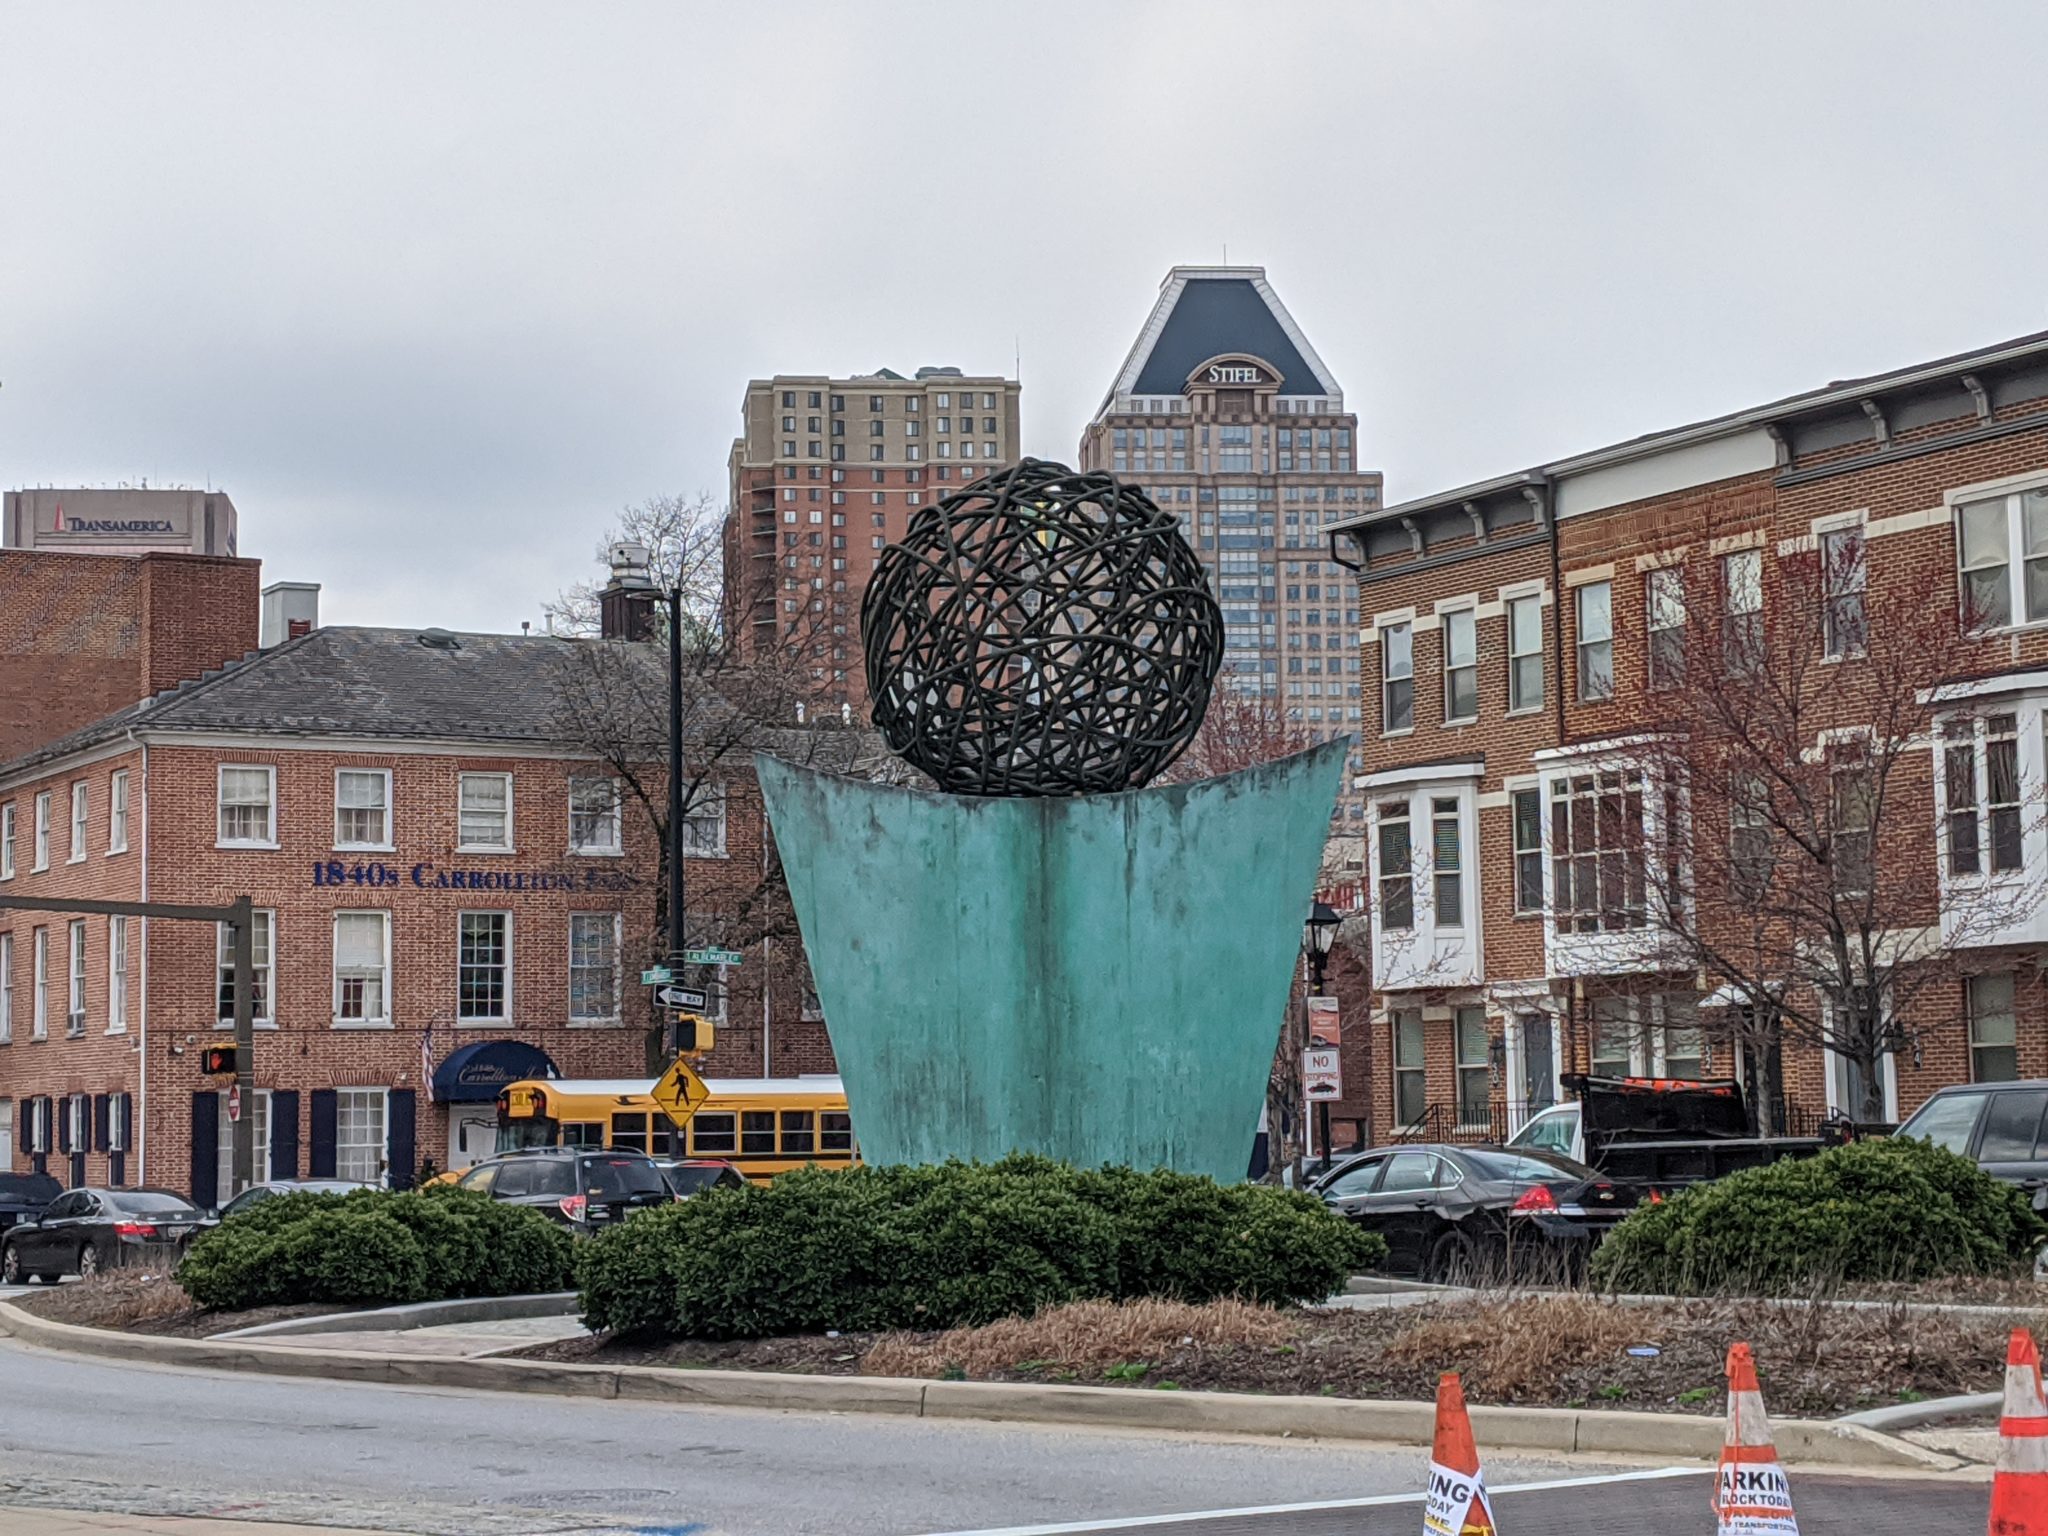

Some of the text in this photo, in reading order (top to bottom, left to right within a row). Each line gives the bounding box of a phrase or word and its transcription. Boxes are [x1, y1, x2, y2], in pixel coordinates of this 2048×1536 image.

[1208, 365, 1262, 383] STIFEL
[66, 517, 174, 533] TRANSAMERICA
[686, 995, 702, 1003] WAY
[1312, 1056, 1329, 1068] NO
[1722, 1471, 1789, 1493] ARKIN
